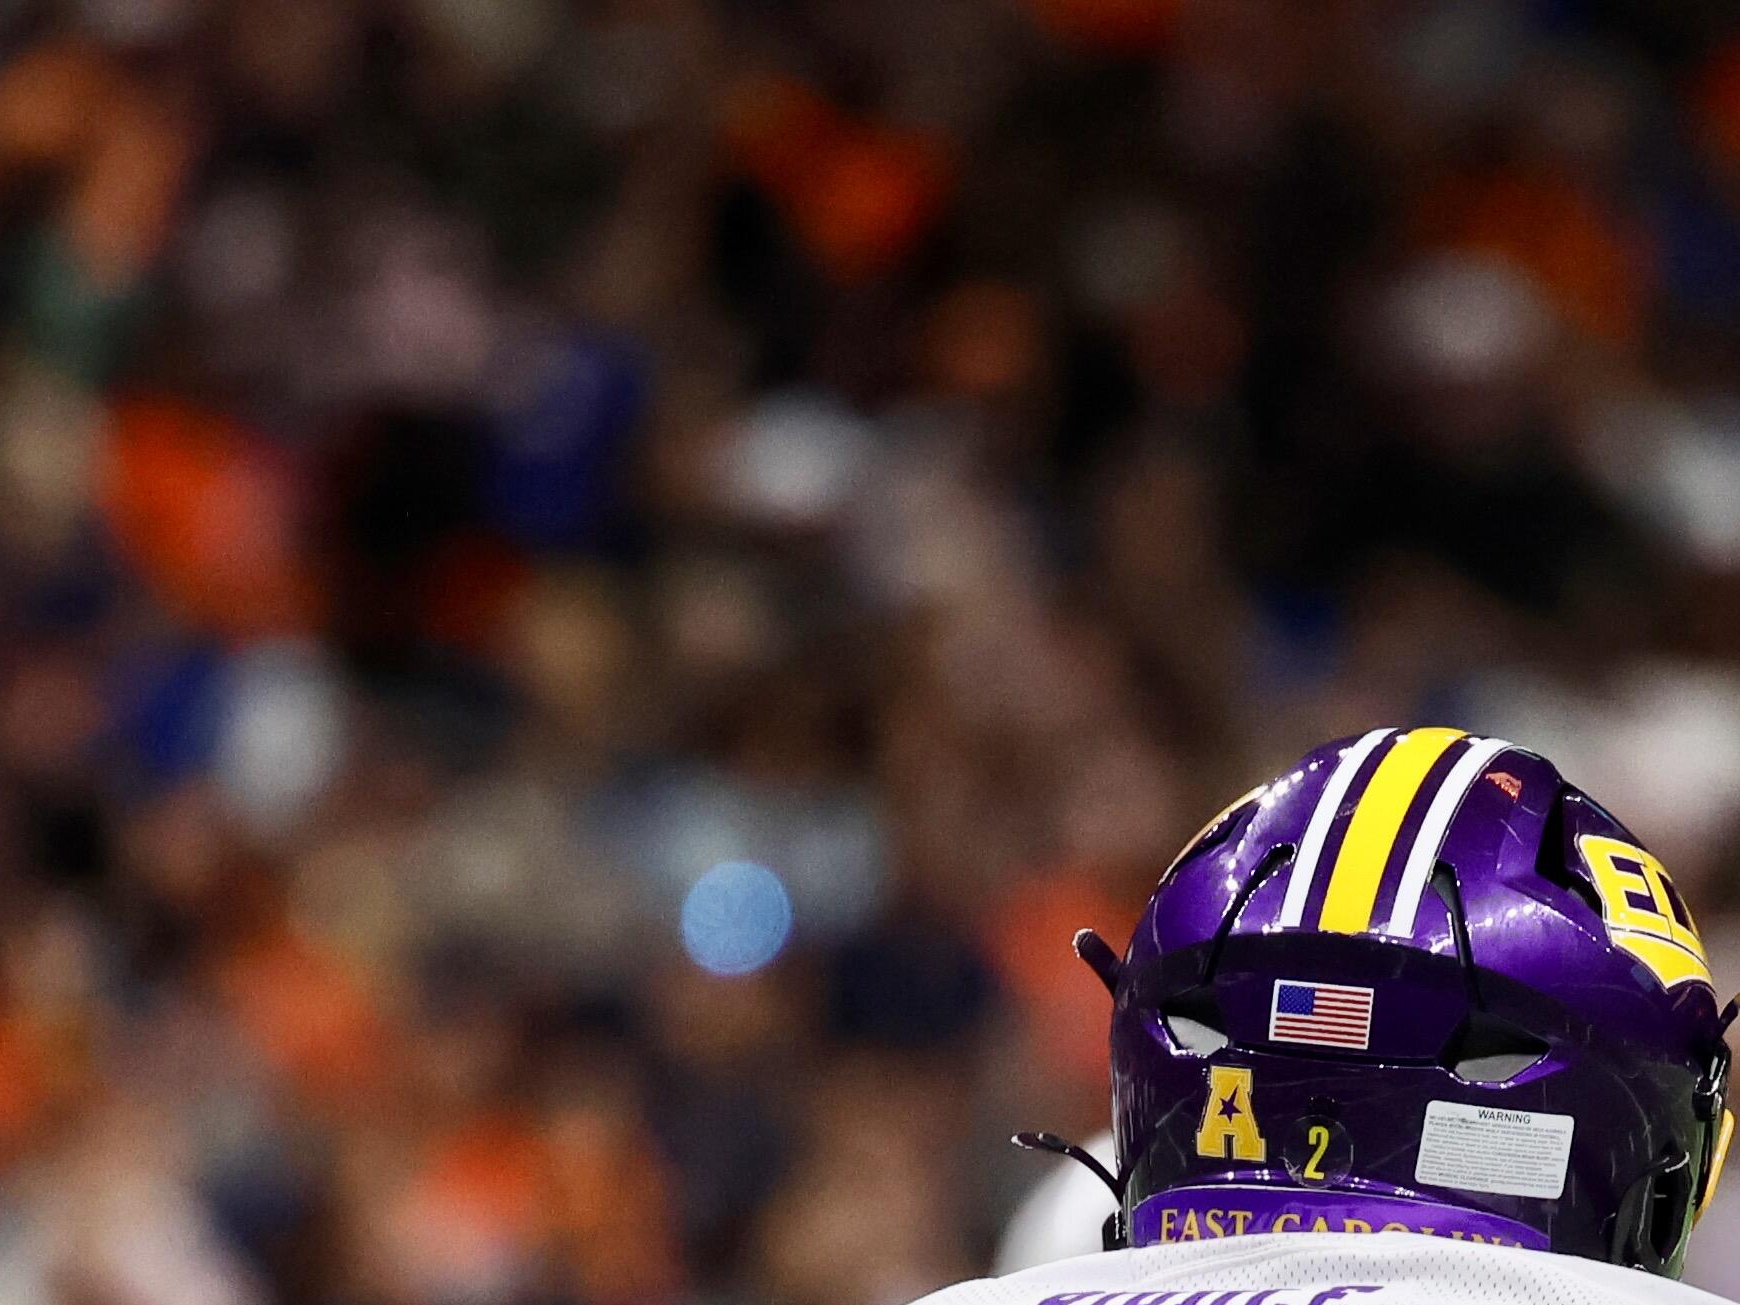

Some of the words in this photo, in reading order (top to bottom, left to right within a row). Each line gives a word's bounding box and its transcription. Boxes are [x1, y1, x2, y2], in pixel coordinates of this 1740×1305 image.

[1478, 1109, 1532, 1125] WARNING
[1303, 1126, 1329, 1181] 2
[1161, 1208, 1253, 1244] EAST
